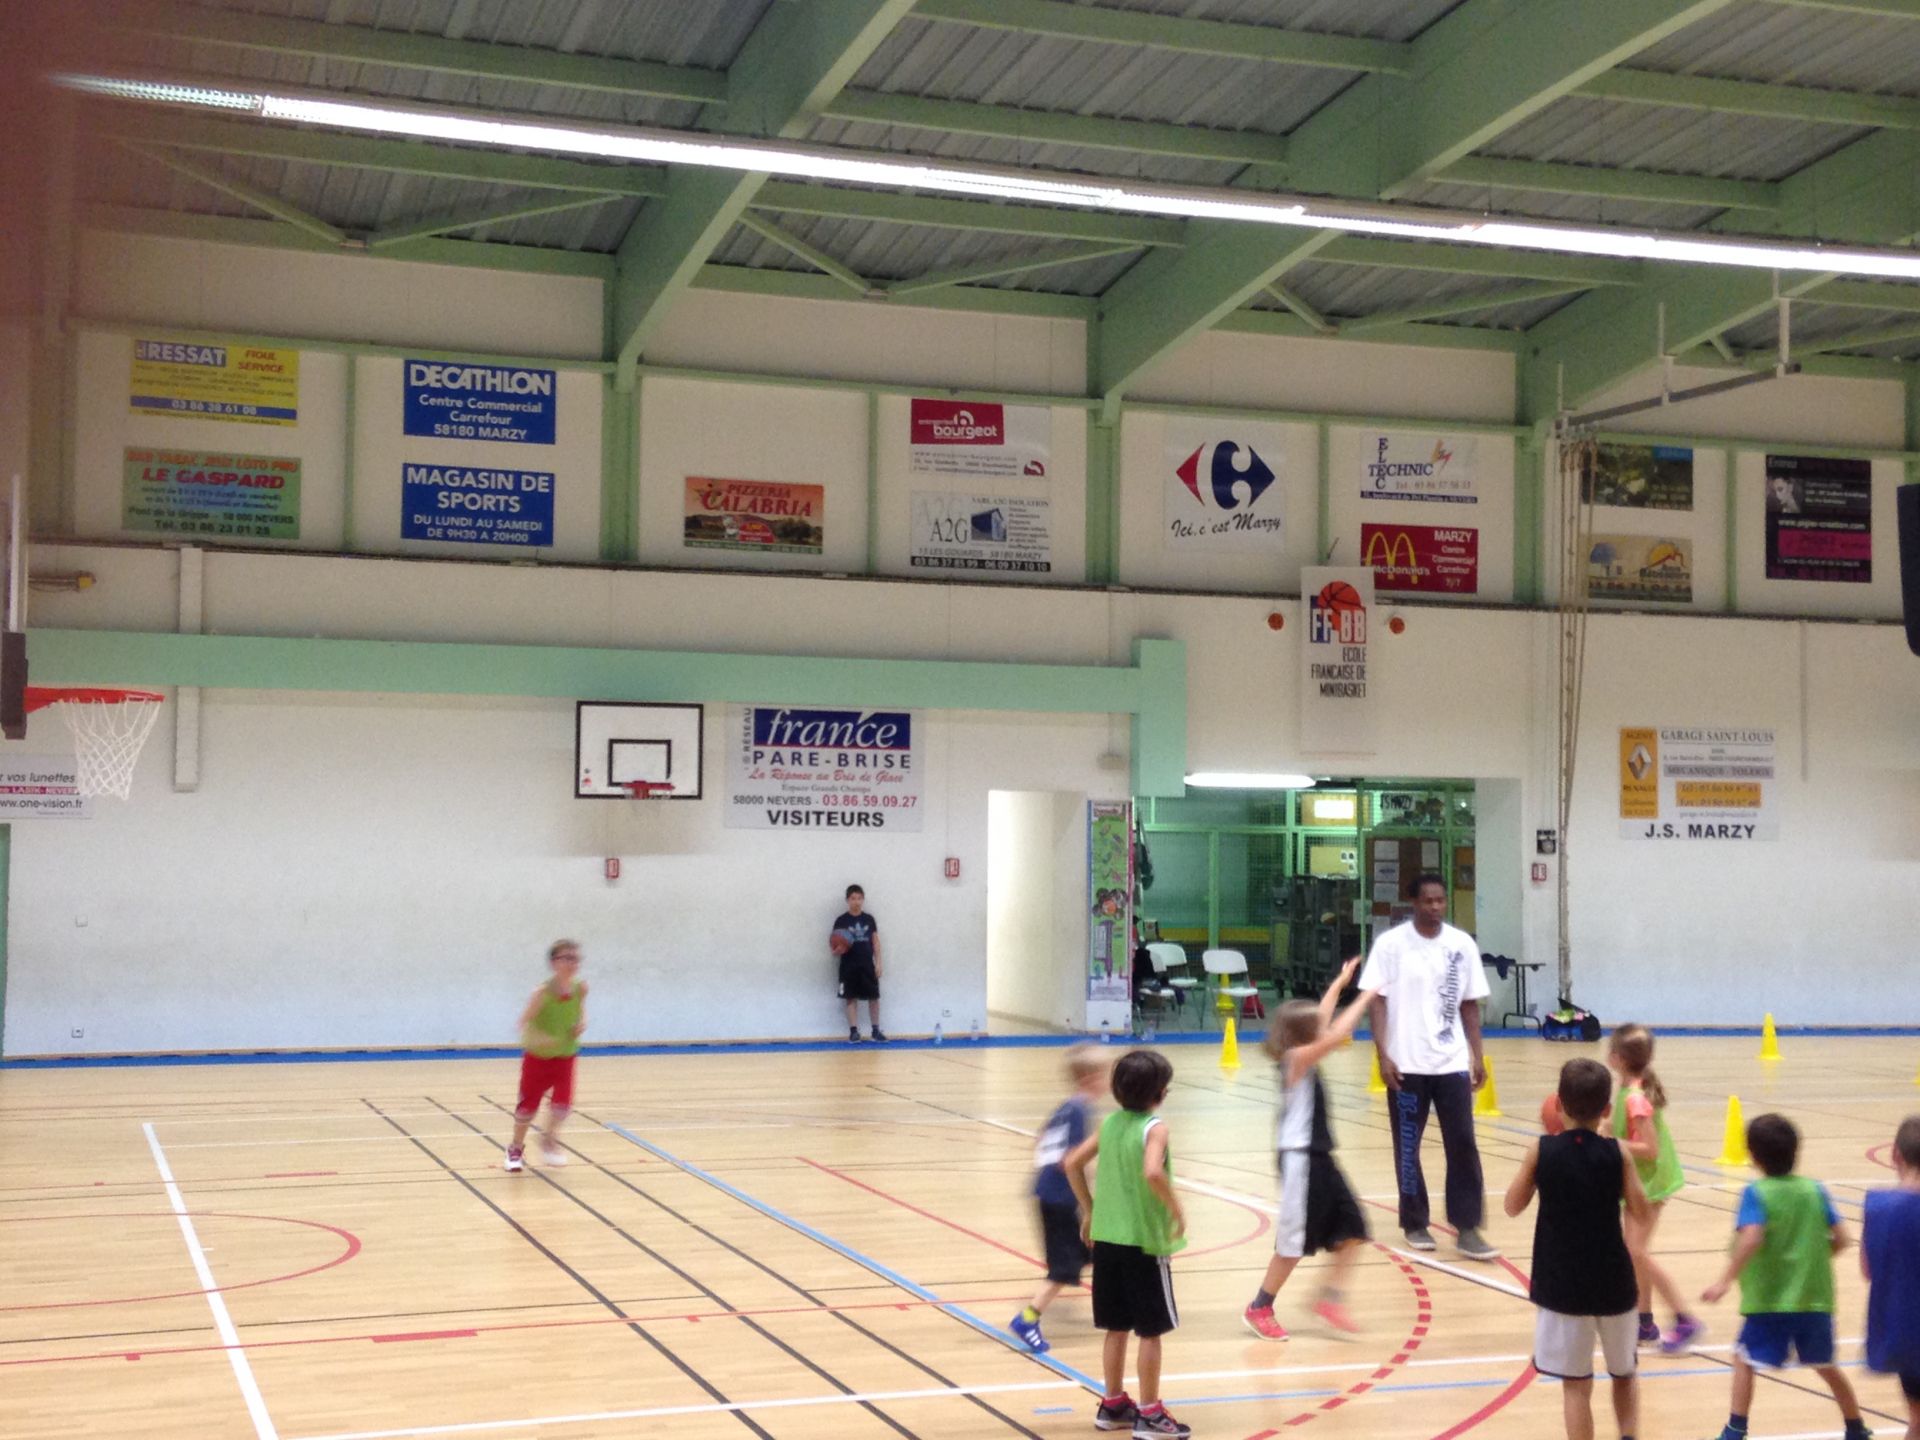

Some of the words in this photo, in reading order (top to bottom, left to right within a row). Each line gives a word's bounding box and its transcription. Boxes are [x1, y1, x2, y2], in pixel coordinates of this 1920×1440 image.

[150, 344, 225, 366] RESSAT
[238, 362, 283, 374] SERVICE
[410, 363, 551, 396] DECATHLON
[419, 394, 464, 408] Centre
[467, 398, 542, 413] Commercial
[450, 410, 512, 425] Carrefour
[434, 423, 475, 437] 58180
[478, 427, 528, 440] MARZY
[933, 424, 998, 442] bourgeot
[142, 468, 171, 481] LE
[176, 470, 285, 489] GASPARD
[1368, 463, 1433, 477] TECHNIC
[407, 467, 514, 490] MAGASIN
[521, 475, 550, 493] DE
[727, 484, 791, 499] PIZZERIA
[437, 491, 521, 513] SPORTS
[702, 488, 812, 517] CALABRIA
[413, 514, 432, 525] DU
[435, 516, 472, 527] LUNDI
[475, 518, 493, 528] AU
[496, 519, 542, 531] SAMEDI
[930, 518, 968, 544] A2G
[1233, 513, 1280, 532] Marzy
[427, 528, 442, 538] DE
[447, 529, 477, 540] 9H30
[493, 531, 528, 542] 20H00
[1434, 530, 1472, 543] MARZY
[766, 709, 897, 749] france
[1661, 730, 1703, 741] GARAGE
[753, 750, 912, 770] PARE-BRISE
[7, 773, 26, 782] vos
[30, 772, 75, 783] lunettes
[733, 795, 764, 805] 58000
[767, 796, 812, 806] NEVERS
[822, 794, 917, 808] 03.86.59.09.27
[767, 810, 884, 828] VISITEURS
[1645, 824, 1680, 839] J.S.
[1688, 825, 1756, 840] MARZY
